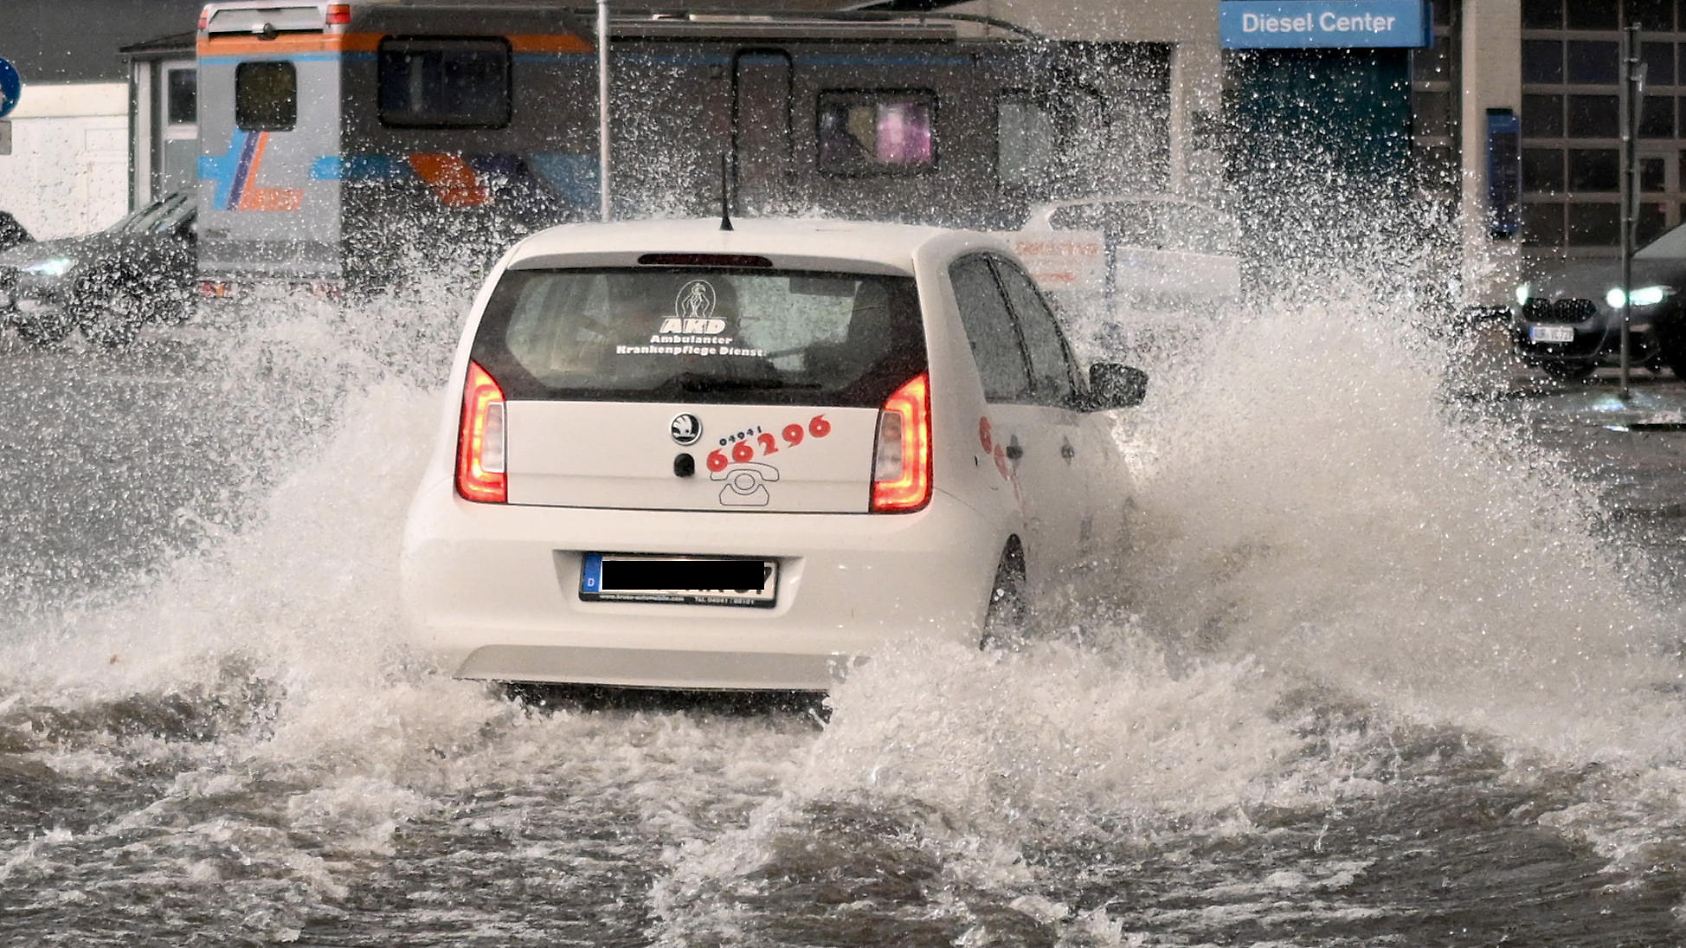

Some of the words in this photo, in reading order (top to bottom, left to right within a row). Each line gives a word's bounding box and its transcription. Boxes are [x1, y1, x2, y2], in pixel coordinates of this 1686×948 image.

[1242, 11, 1312, 32] Diesel
[1319, 11, 1396, 32] Center
[659, 318, 726, 334] AKD
[650, 335, 732, 344] Ambulanter
[616, 345, 717, 356] Krankenpflege
[719, 347, 764, 357] Dienst
[706, 413, 831, 472] 66296
[719, 425, 762, 446] 04941
[587, 578, 594, 587] D
